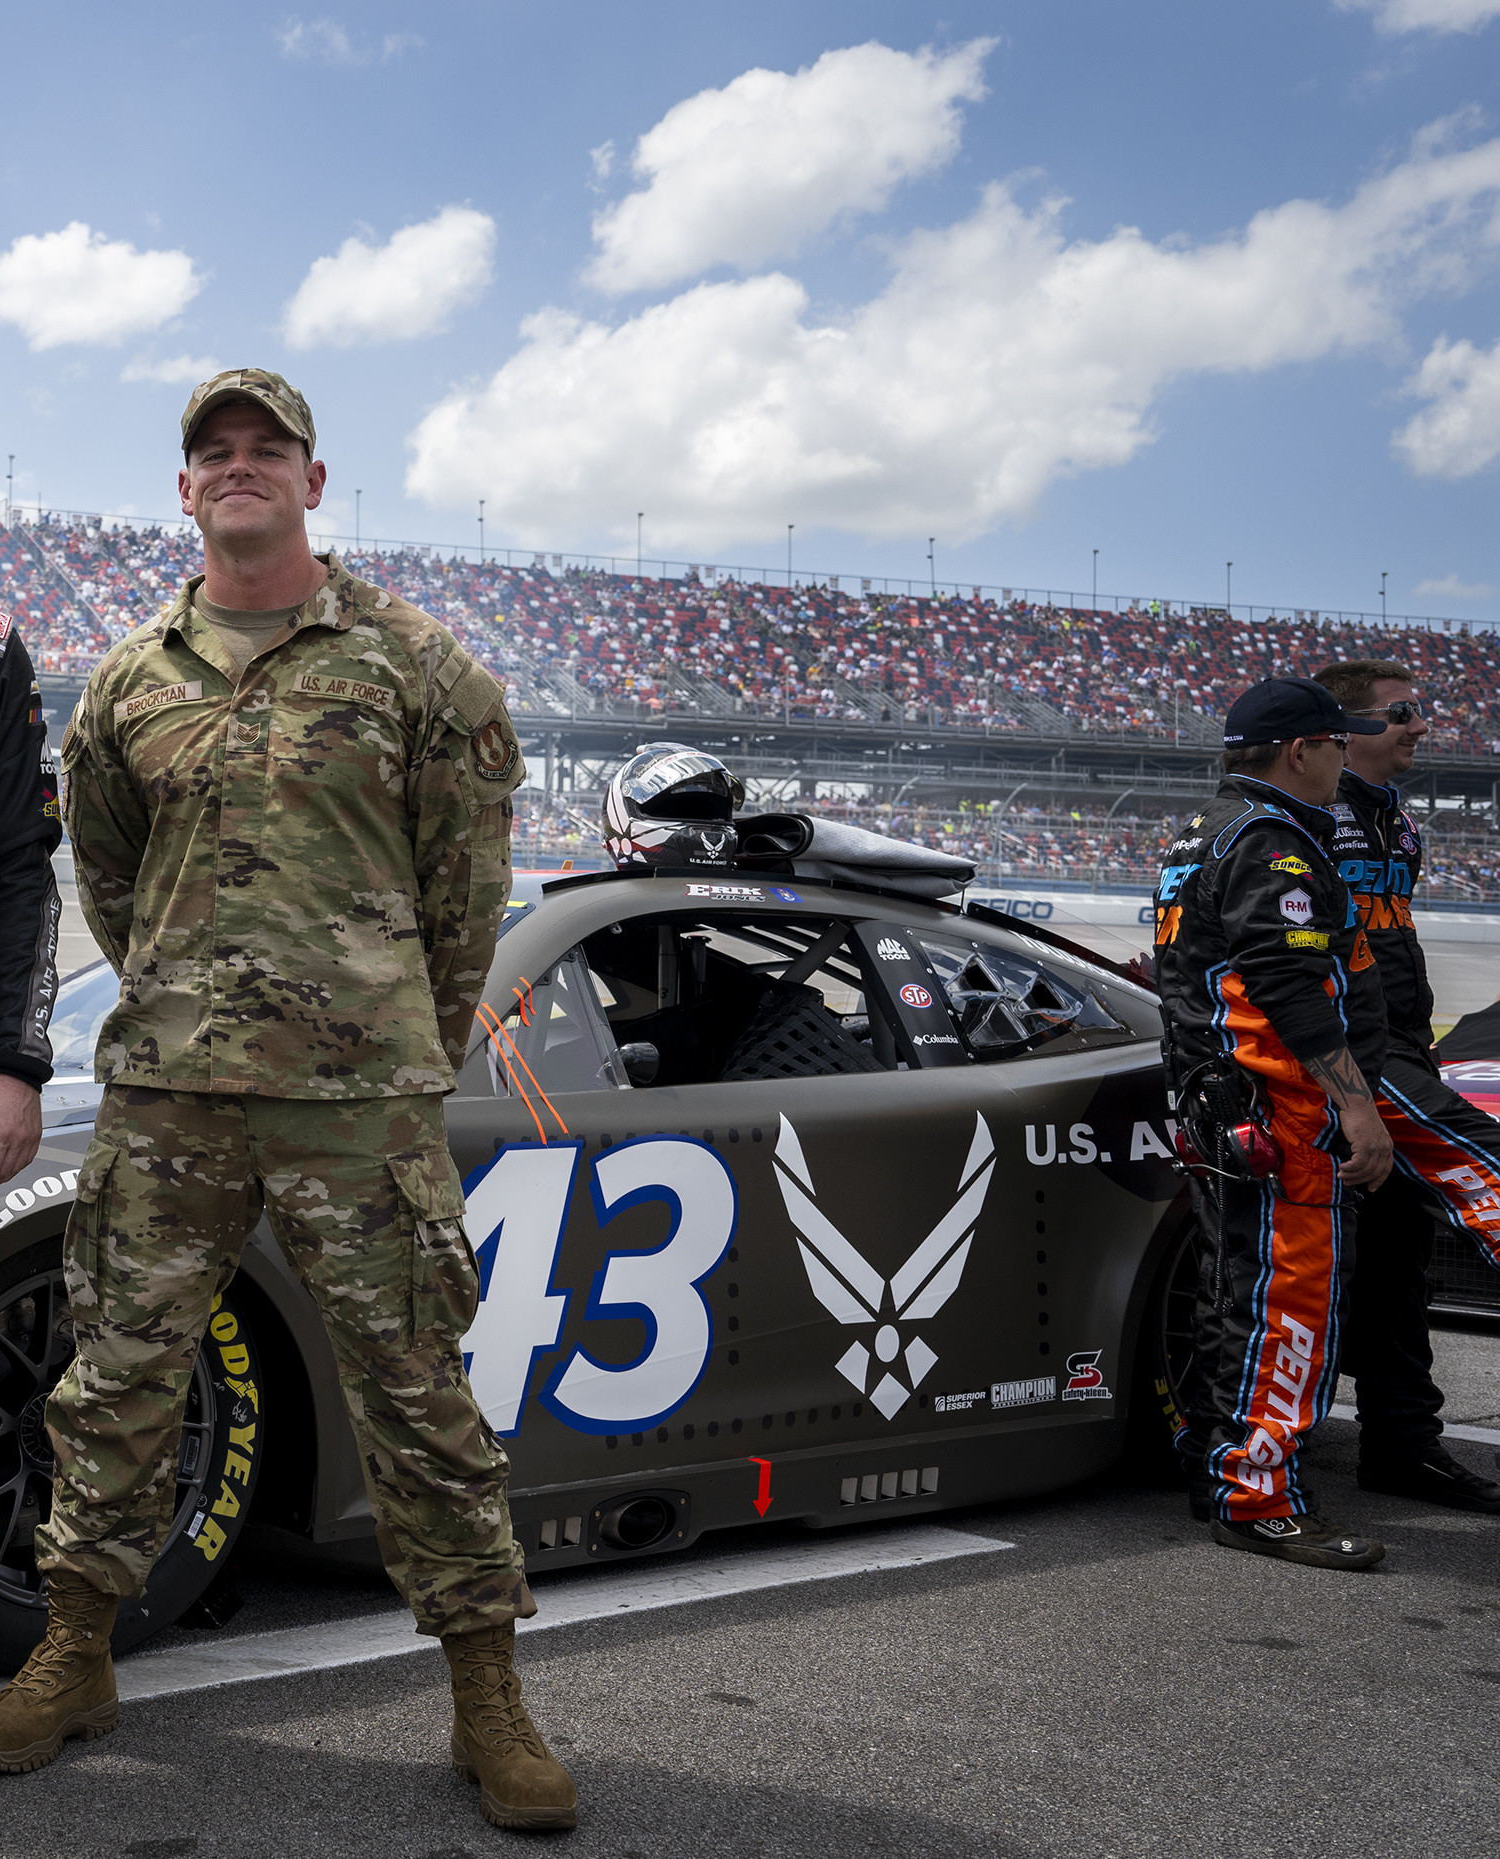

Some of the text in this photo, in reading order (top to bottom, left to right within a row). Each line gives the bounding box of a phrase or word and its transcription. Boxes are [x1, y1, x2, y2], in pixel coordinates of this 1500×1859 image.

[301, 676, 390, 706] U.S. AIR FORCE
[126, 685, 187, 717] BROCKMAN
[685, 883, 763, 897] ERIK
[1285, 901, 1308, 913] R-M
[877, 938, 908, 955] MAC
[39, 966, 54, 1002] AIR
[904, 987, 929, 1005] STP
[34, 1004, 48, 1041] U.S.
[923, 1034, 959, 1044] Columbia
[1025, 1123, 1112, 1166] U.S.
[459, 1136, 738, 1436] 43
[946, 1391, 986, 1403] SUPERIOR
[992, 1377, 1055, 1403] CHAMPION
[1062, 1388, 1107, 1401] safety-kleen
[946, 1400, 973, 1411] ESSEX
